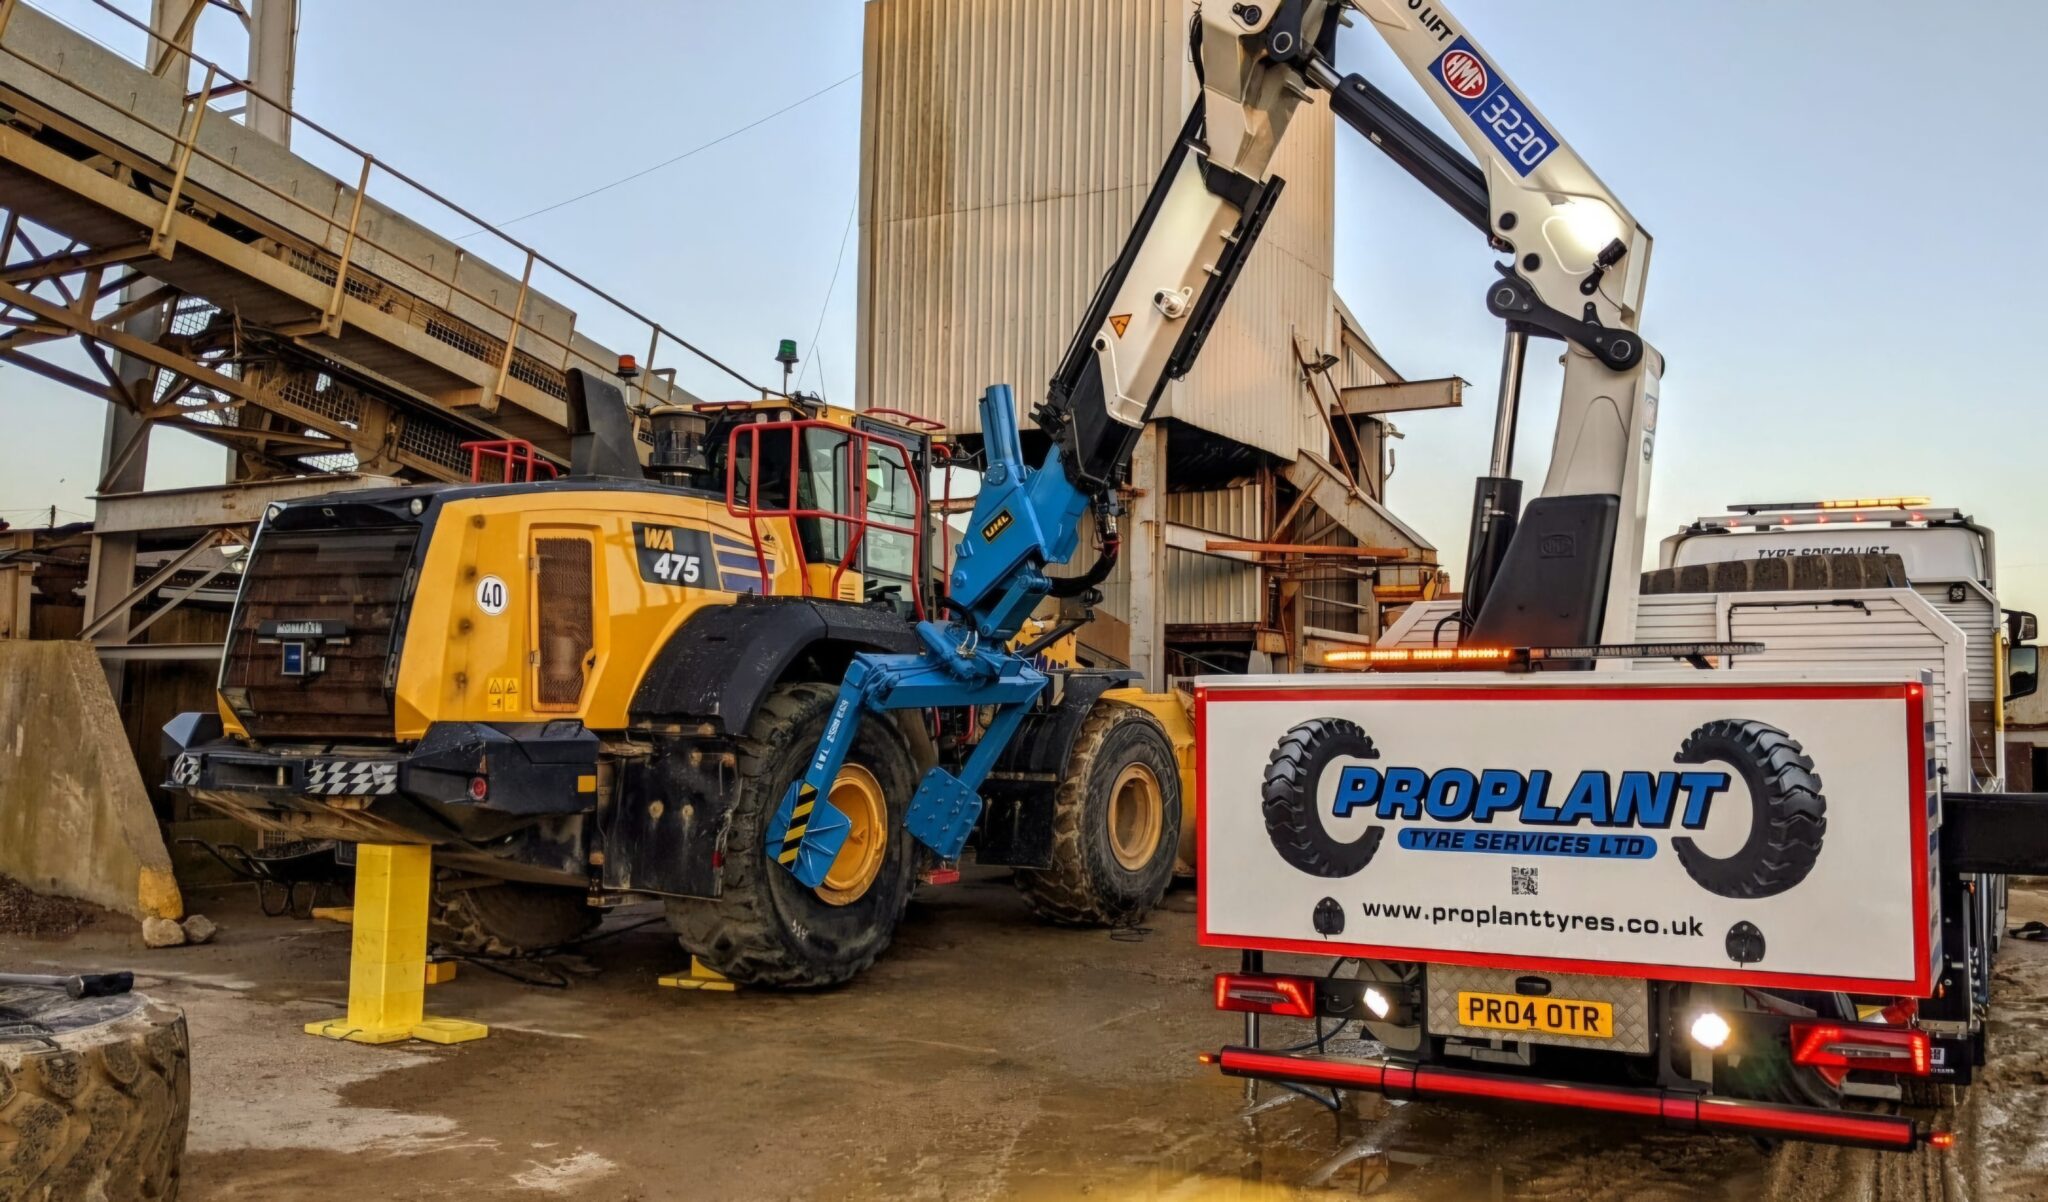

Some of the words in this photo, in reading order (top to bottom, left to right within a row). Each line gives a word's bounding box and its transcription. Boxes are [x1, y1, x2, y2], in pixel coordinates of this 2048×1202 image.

[1419, 7, 1453, 42] LIFT
[1446, 54, 1483, 92] HMF
[1480, 94, 1548, 166] 3220
[644, 527, 674, 551] WA
[653, 552, 700, 583] 475
[481, 582, 502, 607] 40
[1332, 766, 1731, 830] PROPLANT
[1409, 830, 1466, 849] TYRE
[1473, 832, 1591, 854] SERVICES
[1599, 836, 1645, 856] LTD
[1362, 902, 1704, 937] www.proplanttyres.co.uk
[1547, 1003, 1599, 1032] OTR
